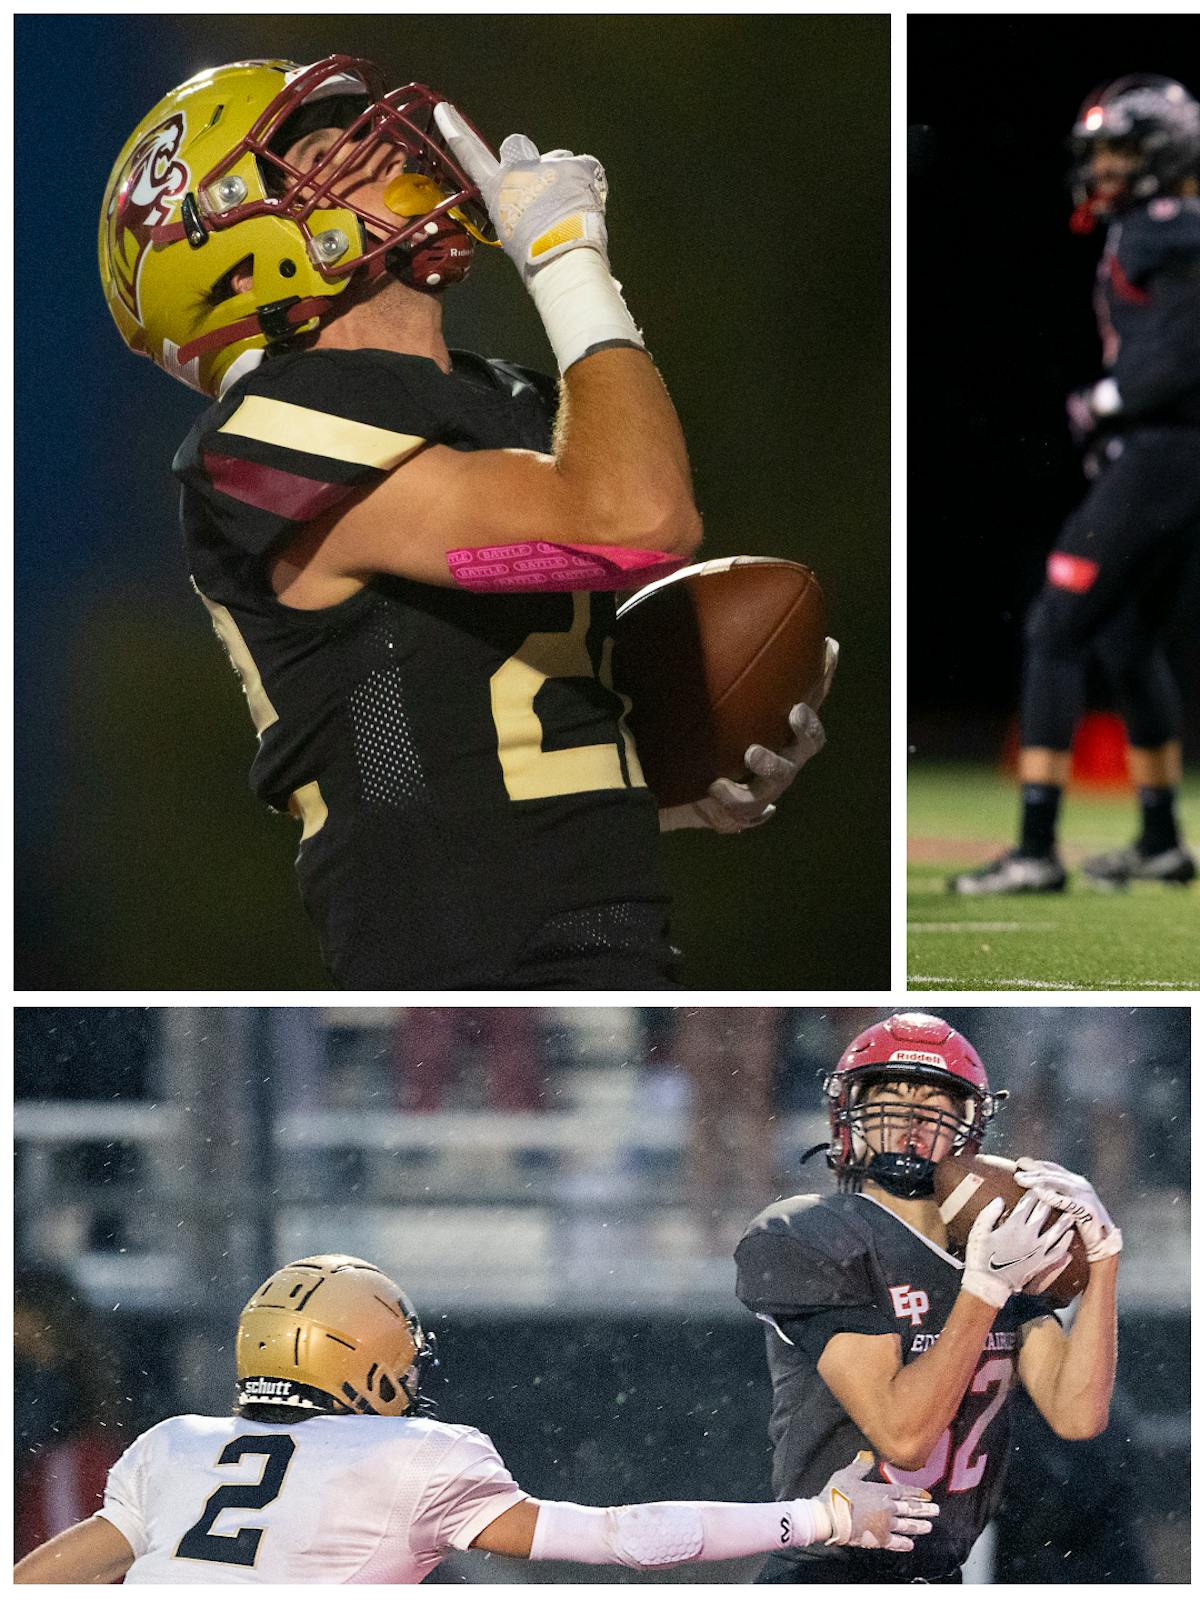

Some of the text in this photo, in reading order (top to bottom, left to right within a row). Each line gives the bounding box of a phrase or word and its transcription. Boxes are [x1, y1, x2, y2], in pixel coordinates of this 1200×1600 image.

[483, 547, 527, 560] BATTLE
[459, 566, 504, 578] BATTLE
[519, 558, 563, 570] BATTLE
[896, 1053, 940, 1064] Riddell
[888, 1283, 930, 1327] EP
[245, 1377, 292, 1396] schutt
[171, 1432, 297, 1569] 2
